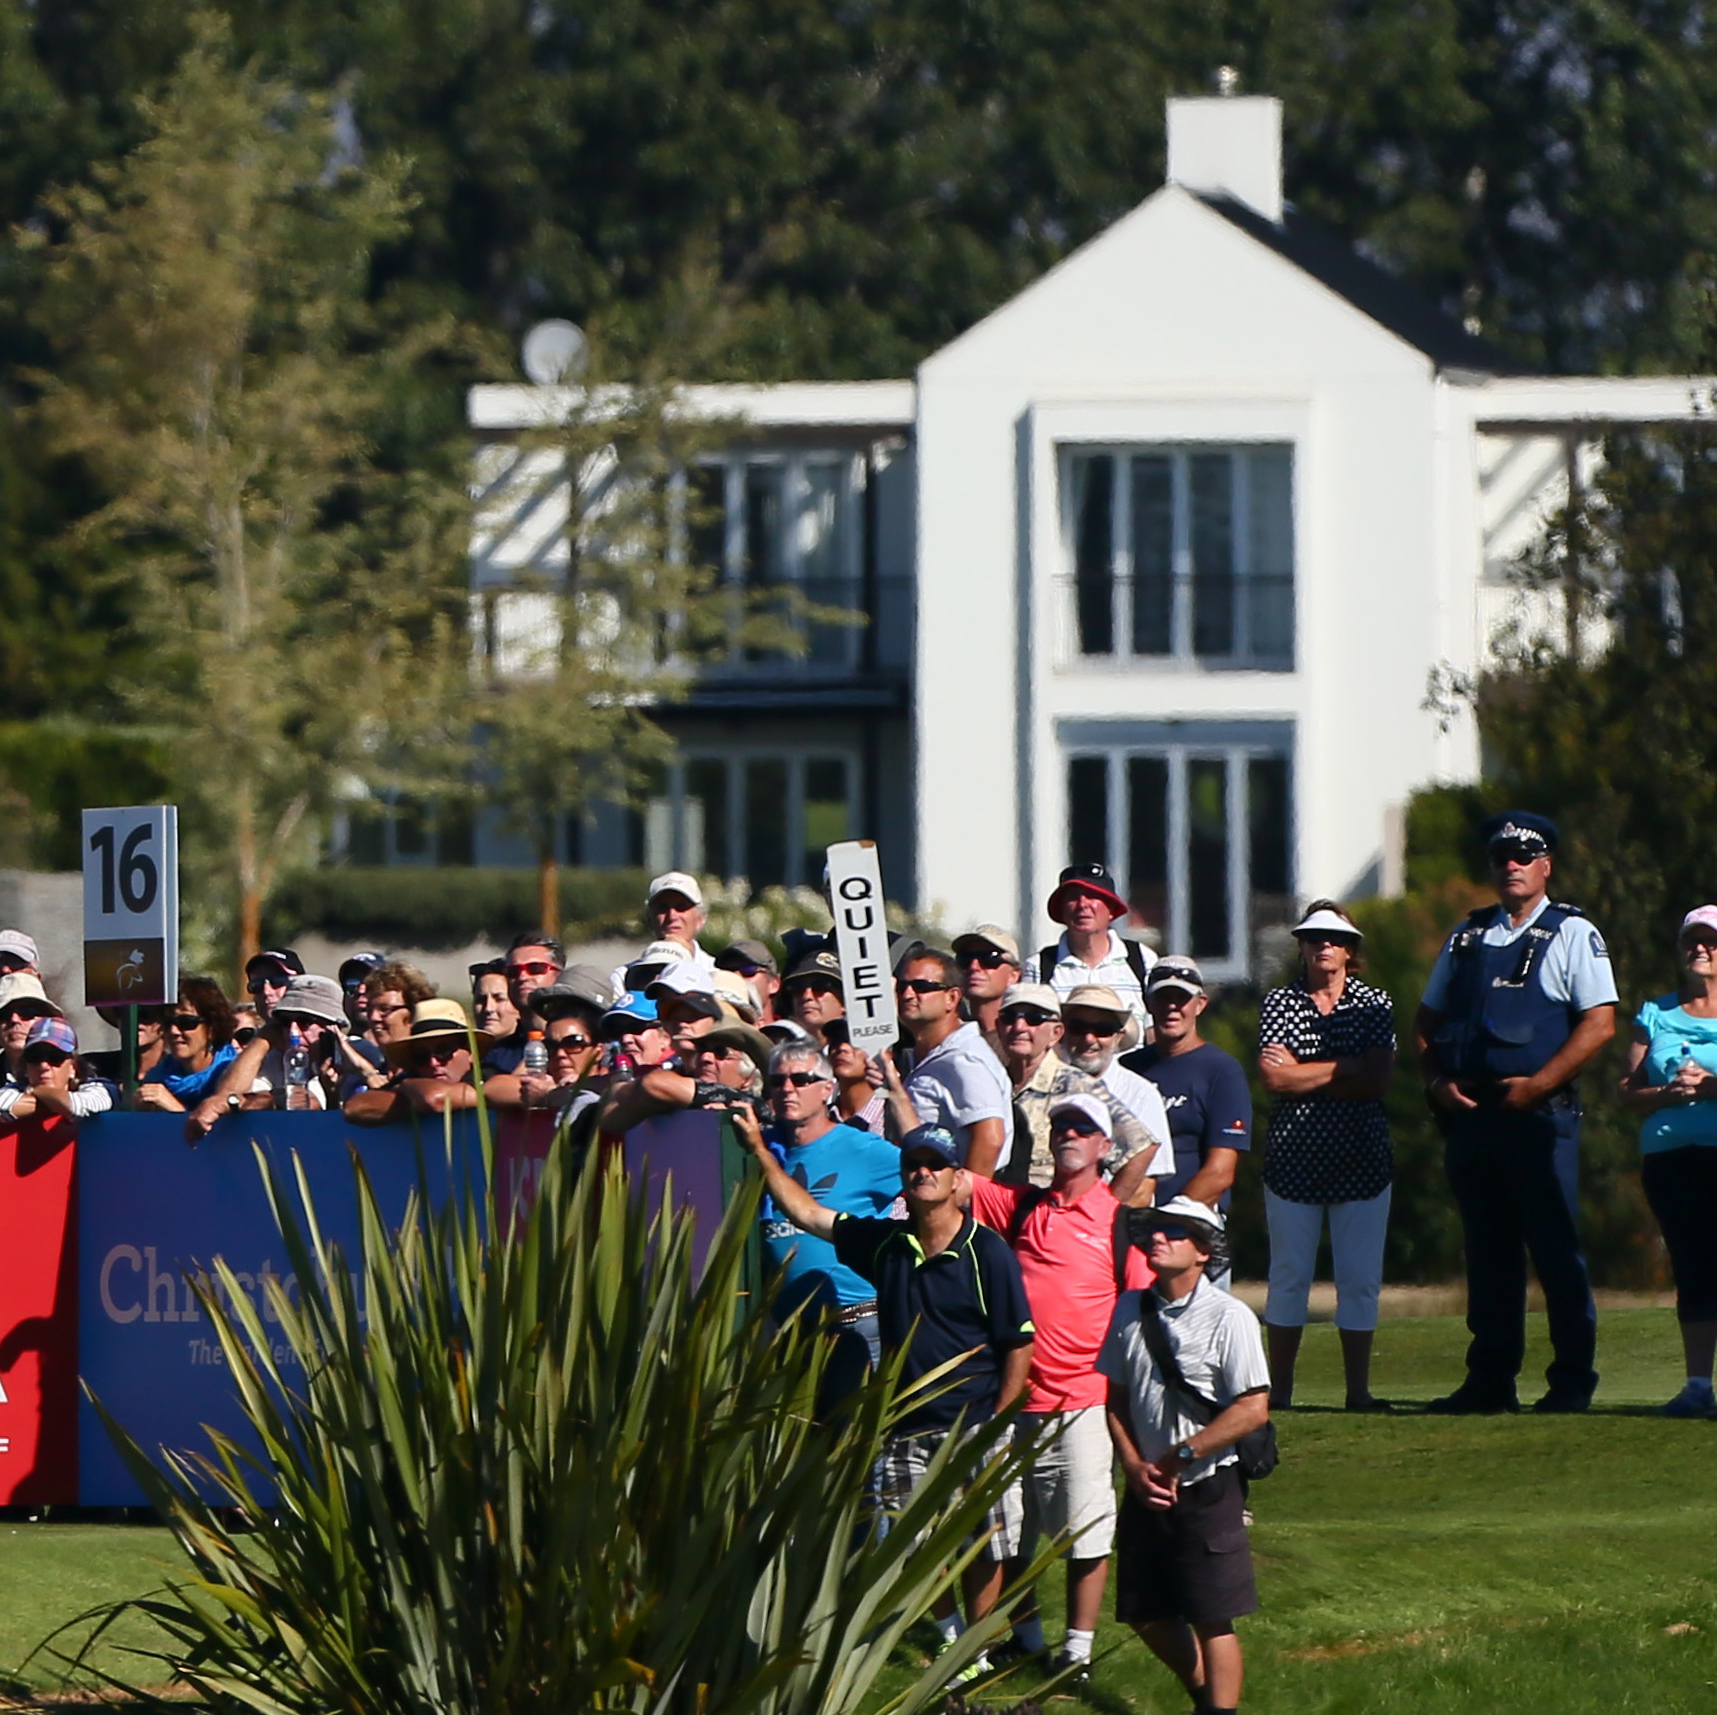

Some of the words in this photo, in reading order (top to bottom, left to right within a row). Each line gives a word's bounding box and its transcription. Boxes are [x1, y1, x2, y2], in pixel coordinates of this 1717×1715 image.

[90, 822, 157, 914] 16
[839, 877, 883, 1018] QUIET
[853, 1023, 894, 1038] PLEASE
